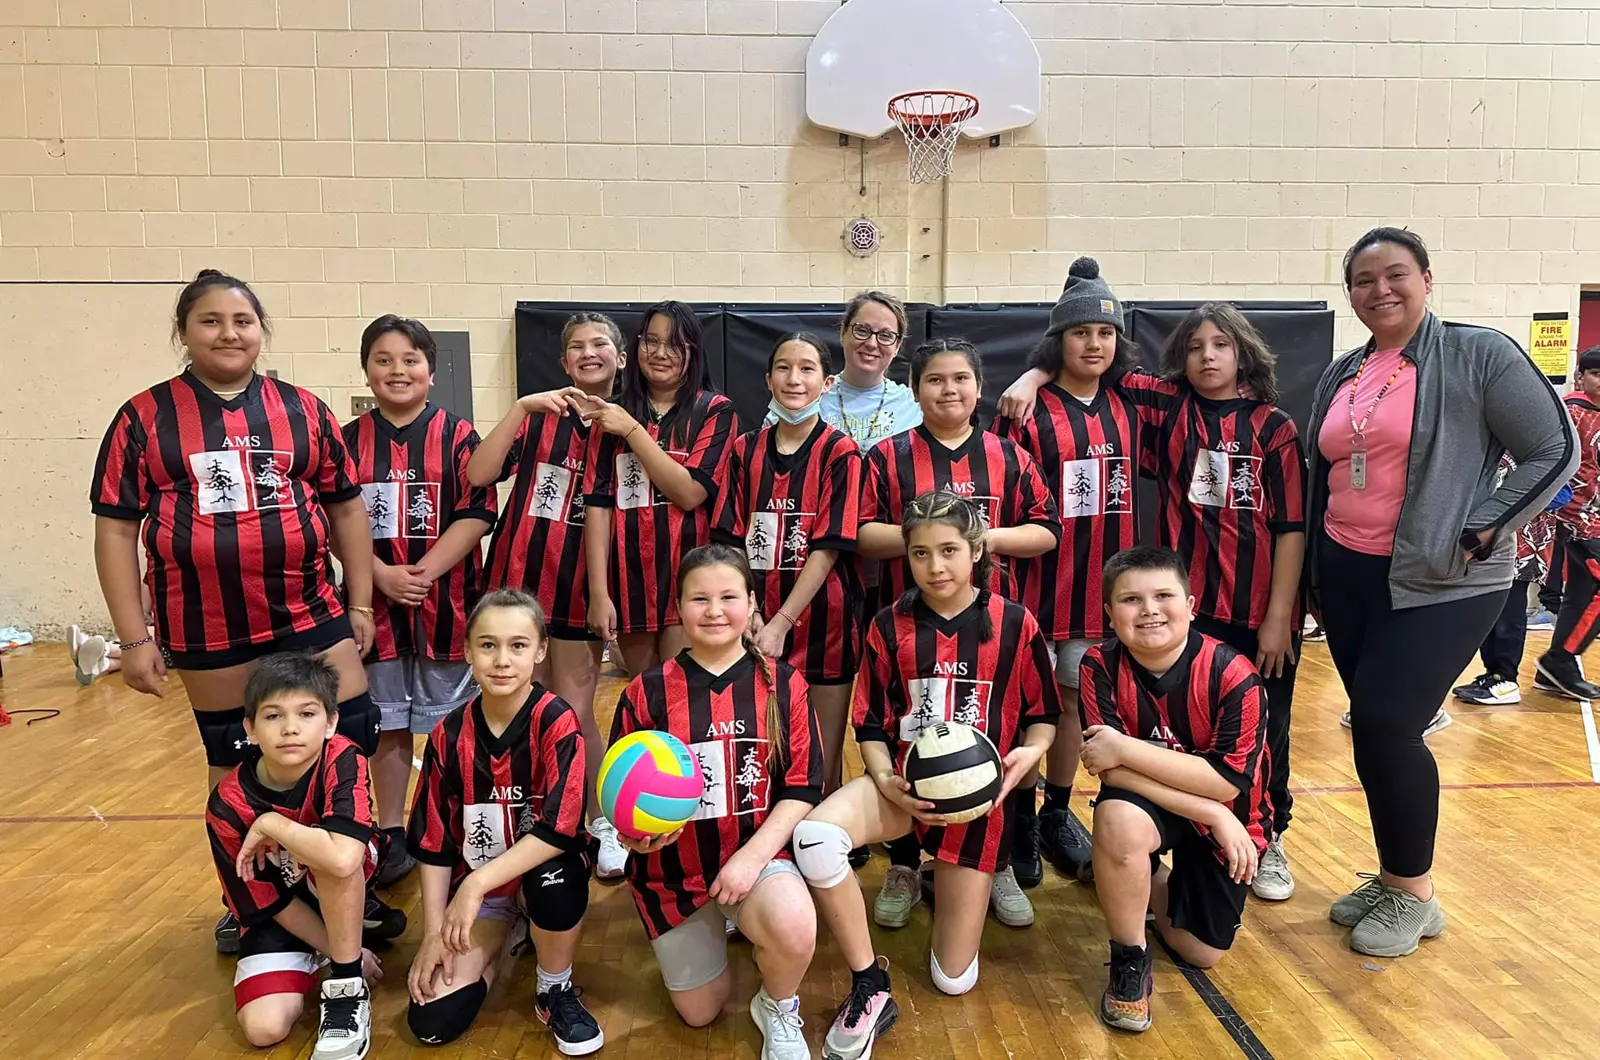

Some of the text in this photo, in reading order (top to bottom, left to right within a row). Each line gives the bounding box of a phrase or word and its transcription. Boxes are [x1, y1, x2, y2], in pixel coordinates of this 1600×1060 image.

[221, 435, 261, 448] AMS
[1086, 442, 1115, 457] AMS
[561, 455, 585, 471] AM
[386, 468, 416, 480] AMS
[943, 481, 976, 493] AMS
[766, 498, 795, 510] AMS
[933, 661, 968, 676] AMS
[705, 719, 746, 738] AMS
[489, 785, 523, 800] AMS
